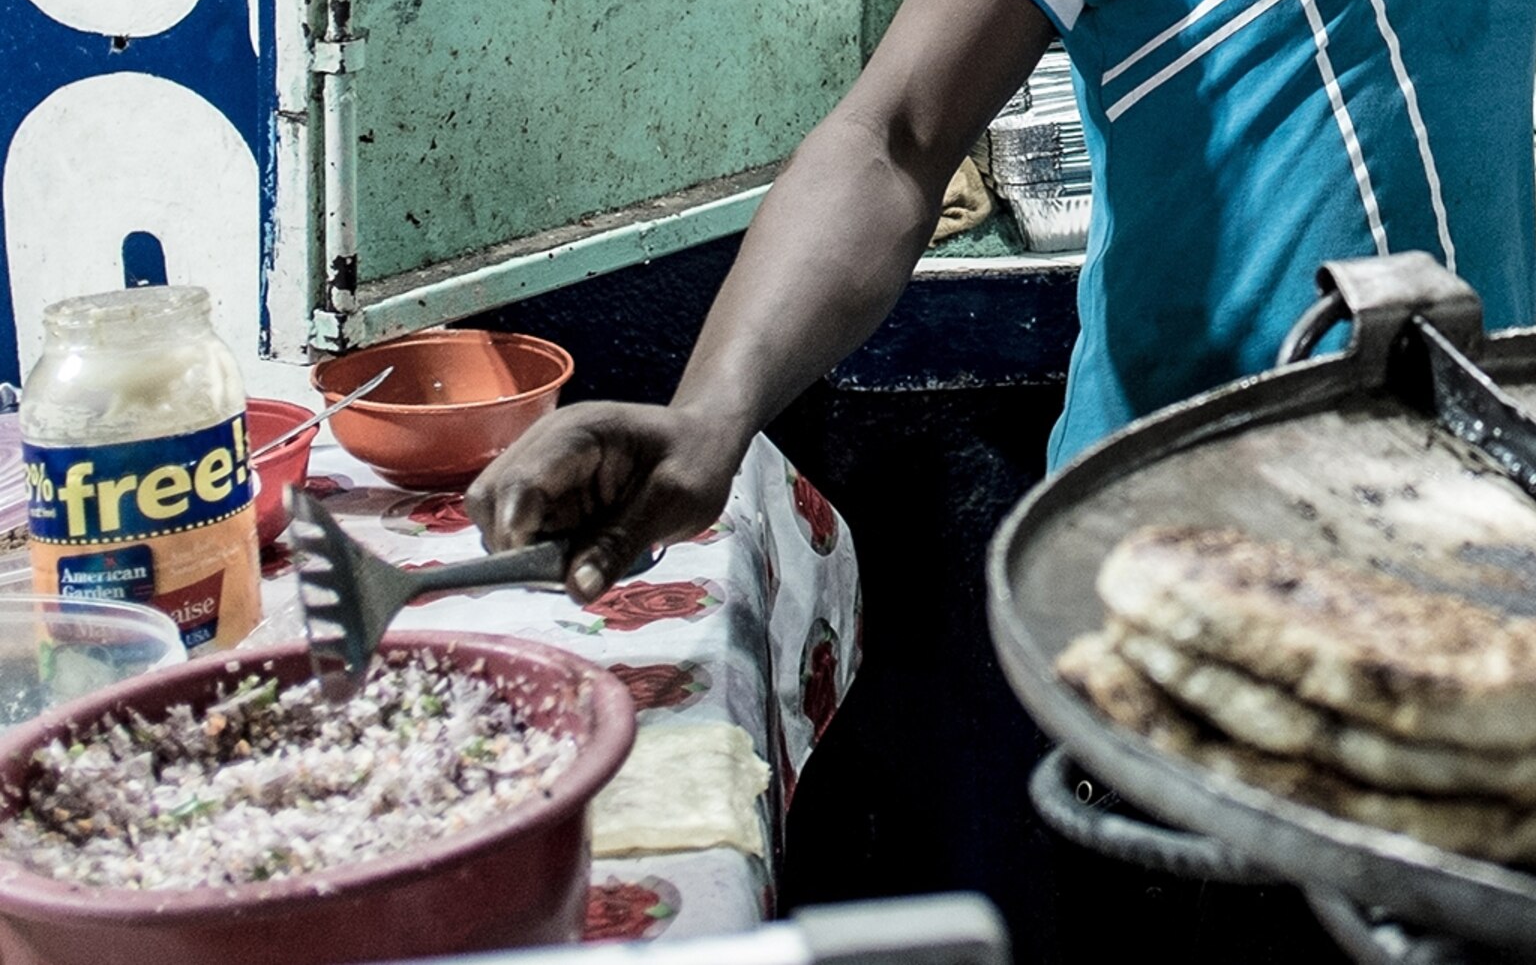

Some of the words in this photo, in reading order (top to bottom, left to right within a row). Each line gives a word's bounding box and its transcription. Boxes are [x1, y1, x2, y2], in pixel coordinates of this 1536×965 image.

[58, 418, 250, 537] free!
[61, 566, 148, 584] American
[62, 584, 126, 600] Garden
